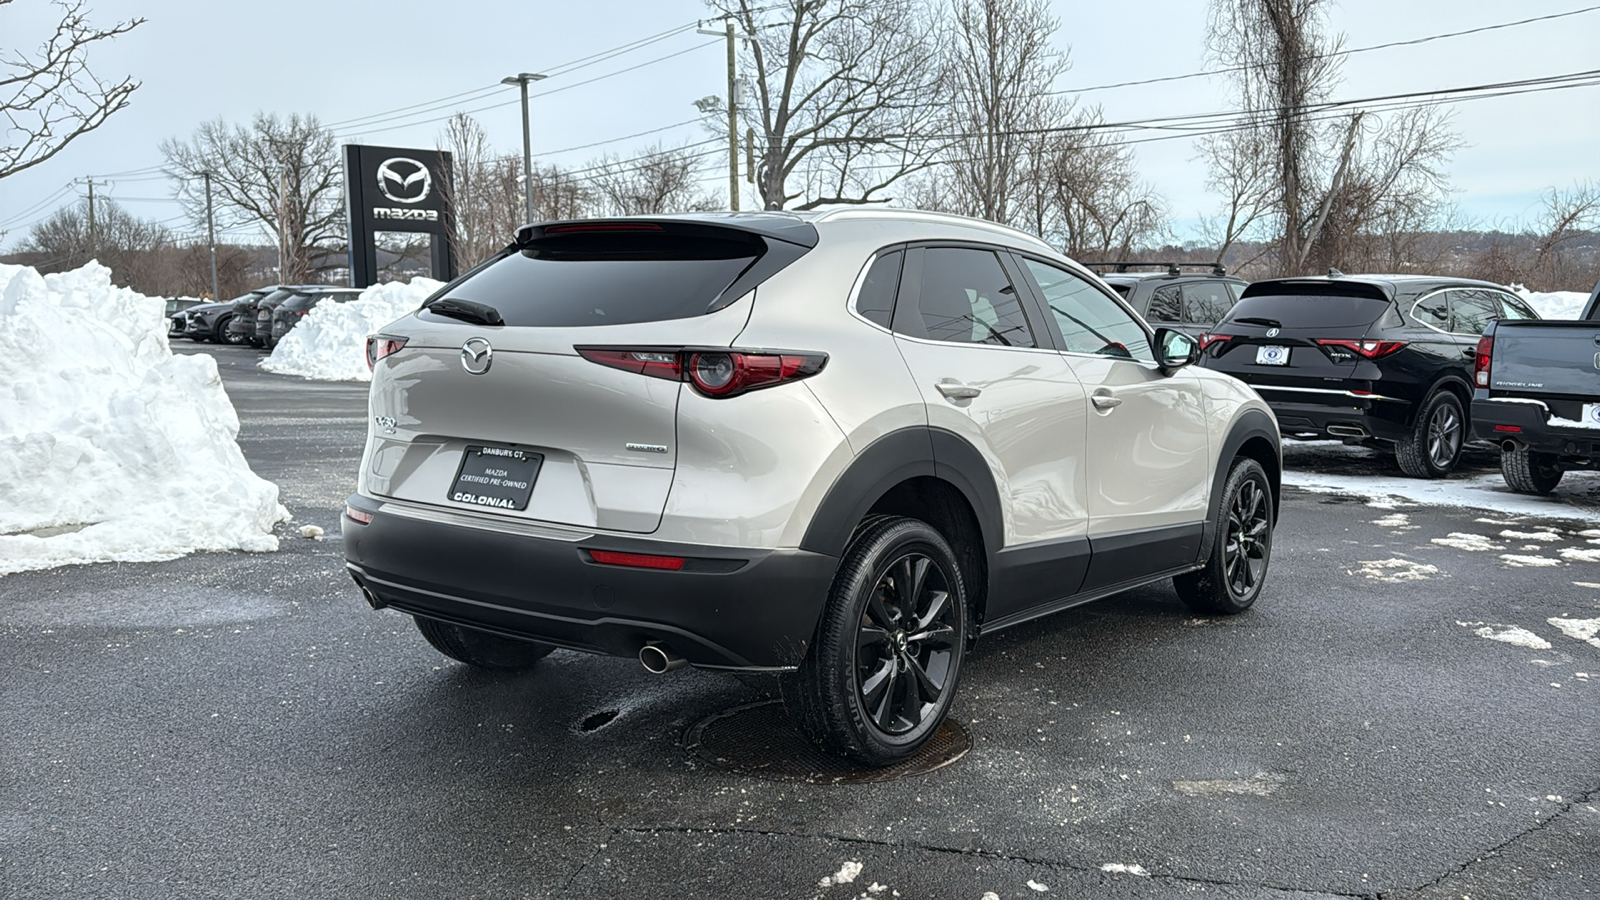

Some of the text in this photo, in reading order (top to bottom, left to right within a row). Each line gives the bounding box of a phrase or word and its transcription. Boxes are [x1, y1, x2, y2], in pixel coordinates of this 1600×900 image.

[373, 207, 438, 221] mazda
[513, 450, 524, 459] CT
[484, 468, 508, 478] MAZDA
[460, 474, 527, 490] CERTIFIED PRE-OWNED
[453, 492, 515, 509] COLONIAL
